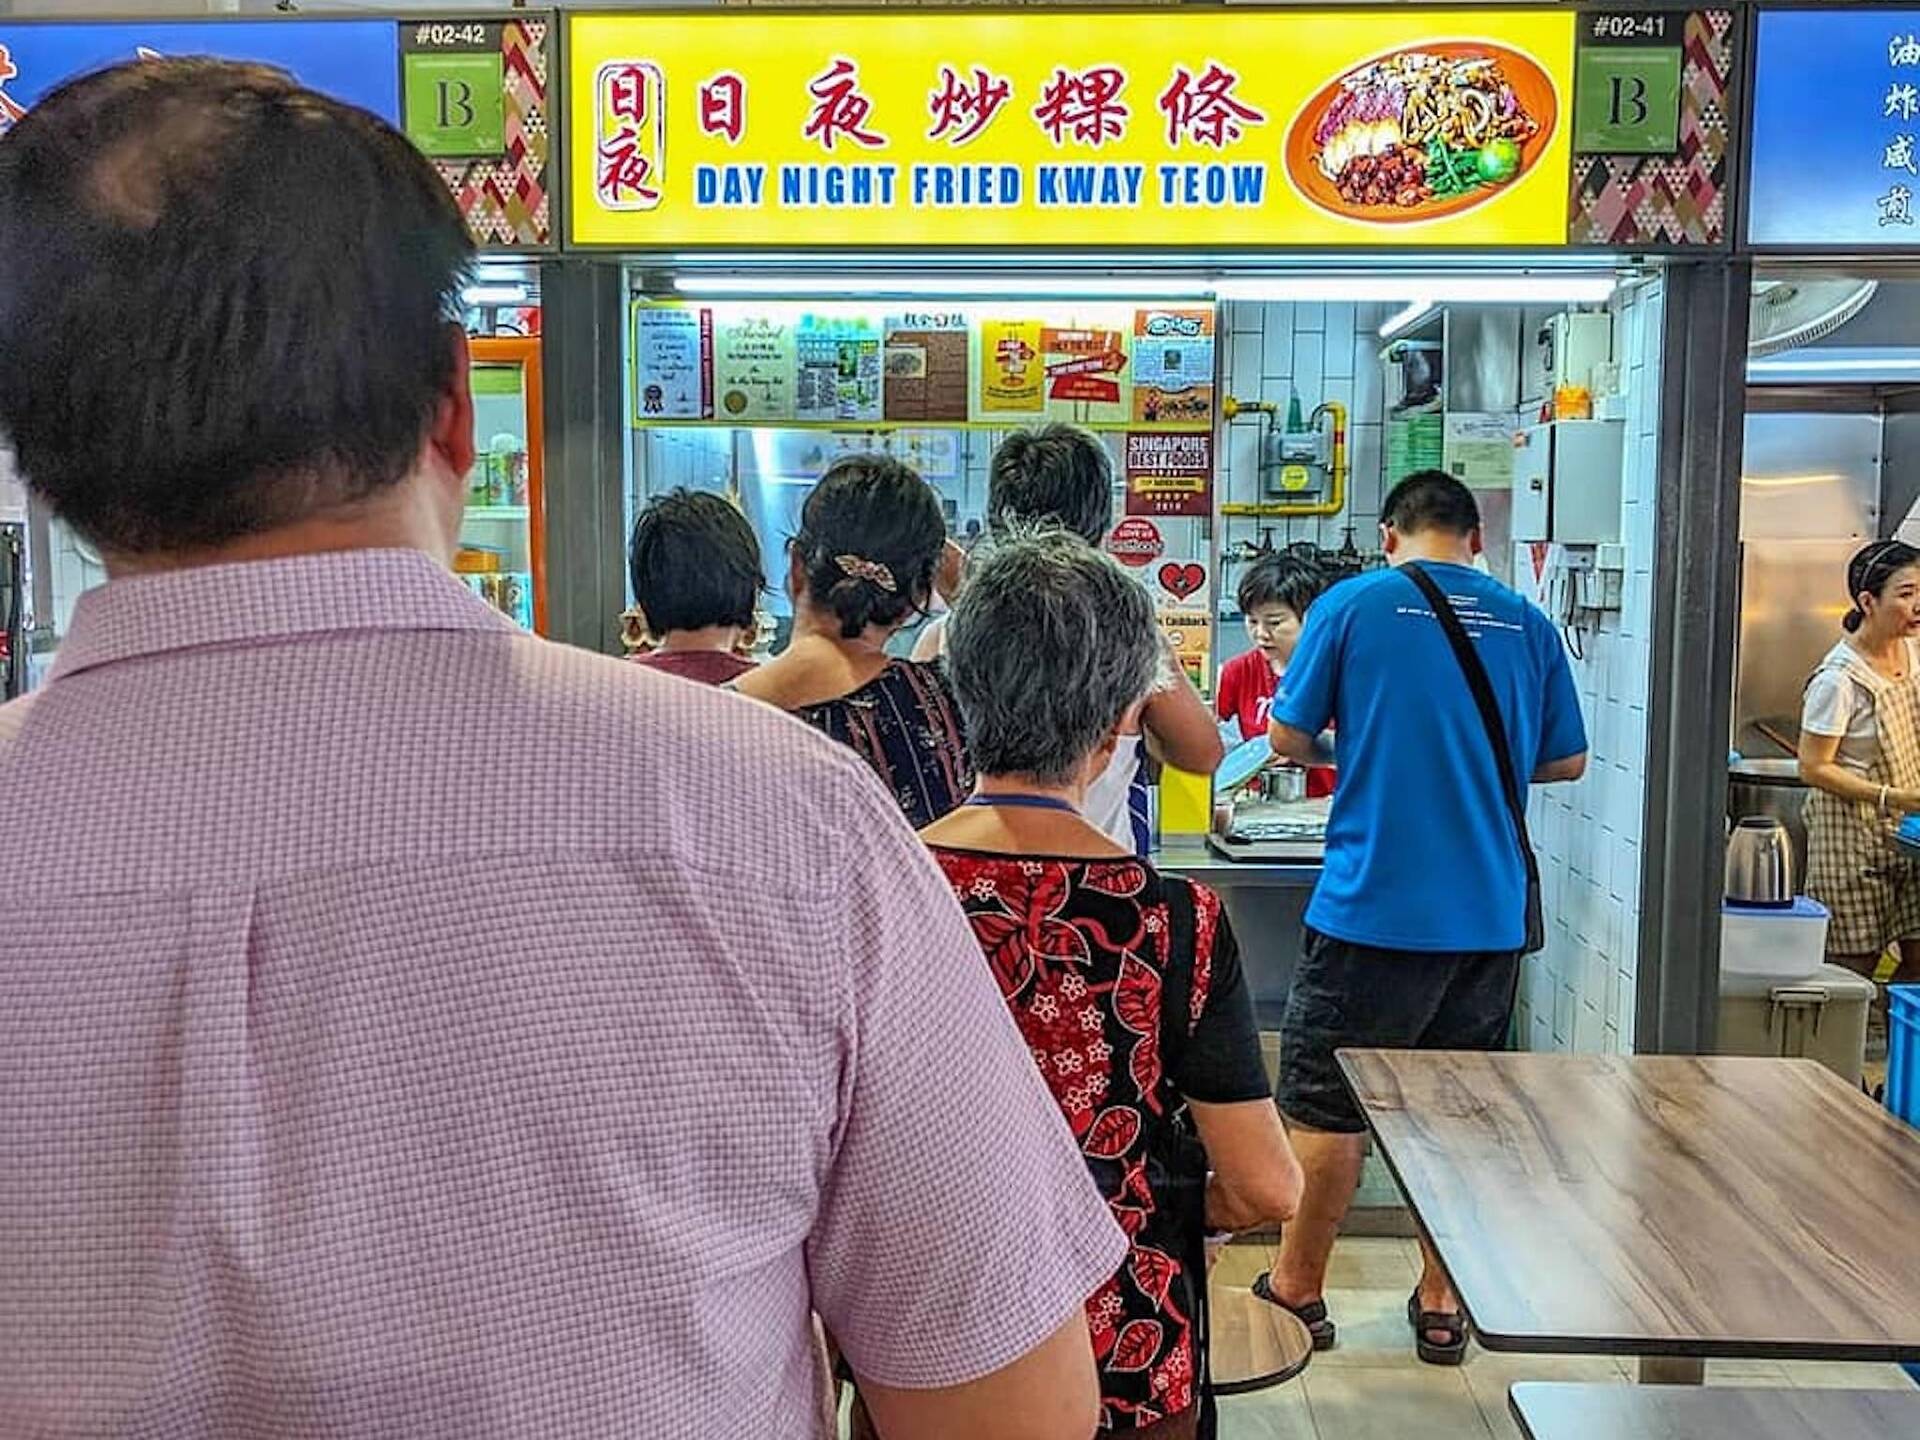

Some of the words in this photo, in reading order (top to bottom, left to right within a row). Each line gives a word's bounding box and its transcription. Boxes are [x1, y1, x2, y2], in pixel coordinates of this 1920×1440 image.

[416, 24, 485, 45] #02-42
[1593, 17, 1665, 37] #02-41
[438, 82, 474, 127] B
[700, 60, 1264, 147] 日夜炒粿條
[1608, 76, 1648, 126] B
[600, 65, 660, 201] 日夜
[697, 166, 763, 205] DAY
[783, 166, 895, 205] NIGHT
[914, 166, 1019, 205] FRIED
[1039, 166, 1142, 205] KWAY
[1160, 165, 1267, 205] TEOW
[1129, 436, 1209, 452] SINGAPORE
